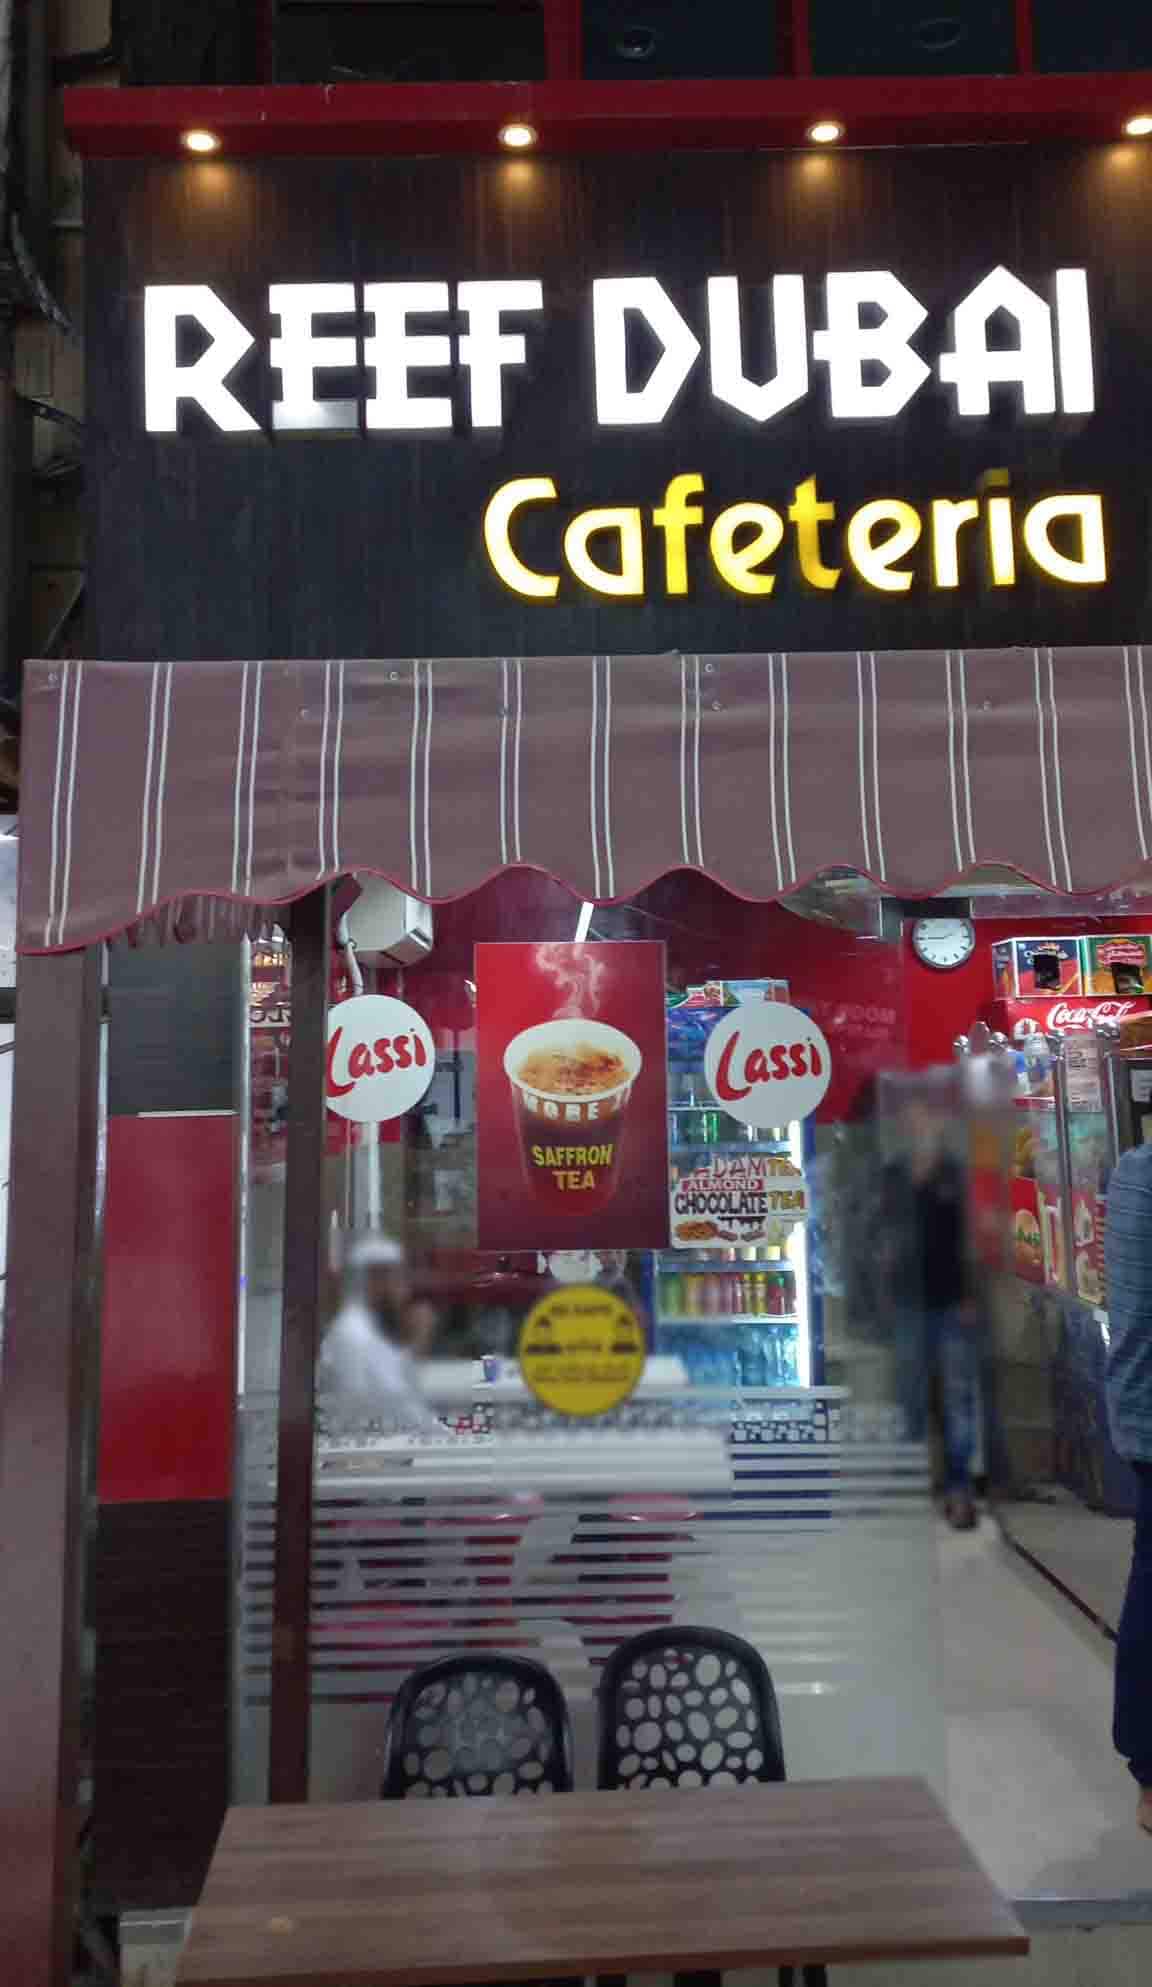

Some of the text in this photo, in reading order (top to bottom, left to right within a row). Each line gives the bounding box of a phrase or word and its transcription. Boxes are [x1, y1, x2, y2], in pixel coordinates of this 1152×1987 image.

[144, 264, 1096, 433] REEF DUBAI
[484, 468, 1108, 598] Cafeteria
[326, 1025, 427, 1098] Lassi
[715, 1030, 823, 1102] Lassi
[531, 1143, 614, 1167] SAFFRON
[551, 1169, 596, 1191] TEA
[674, 1191, 768, 1215] CHOCOLATE
